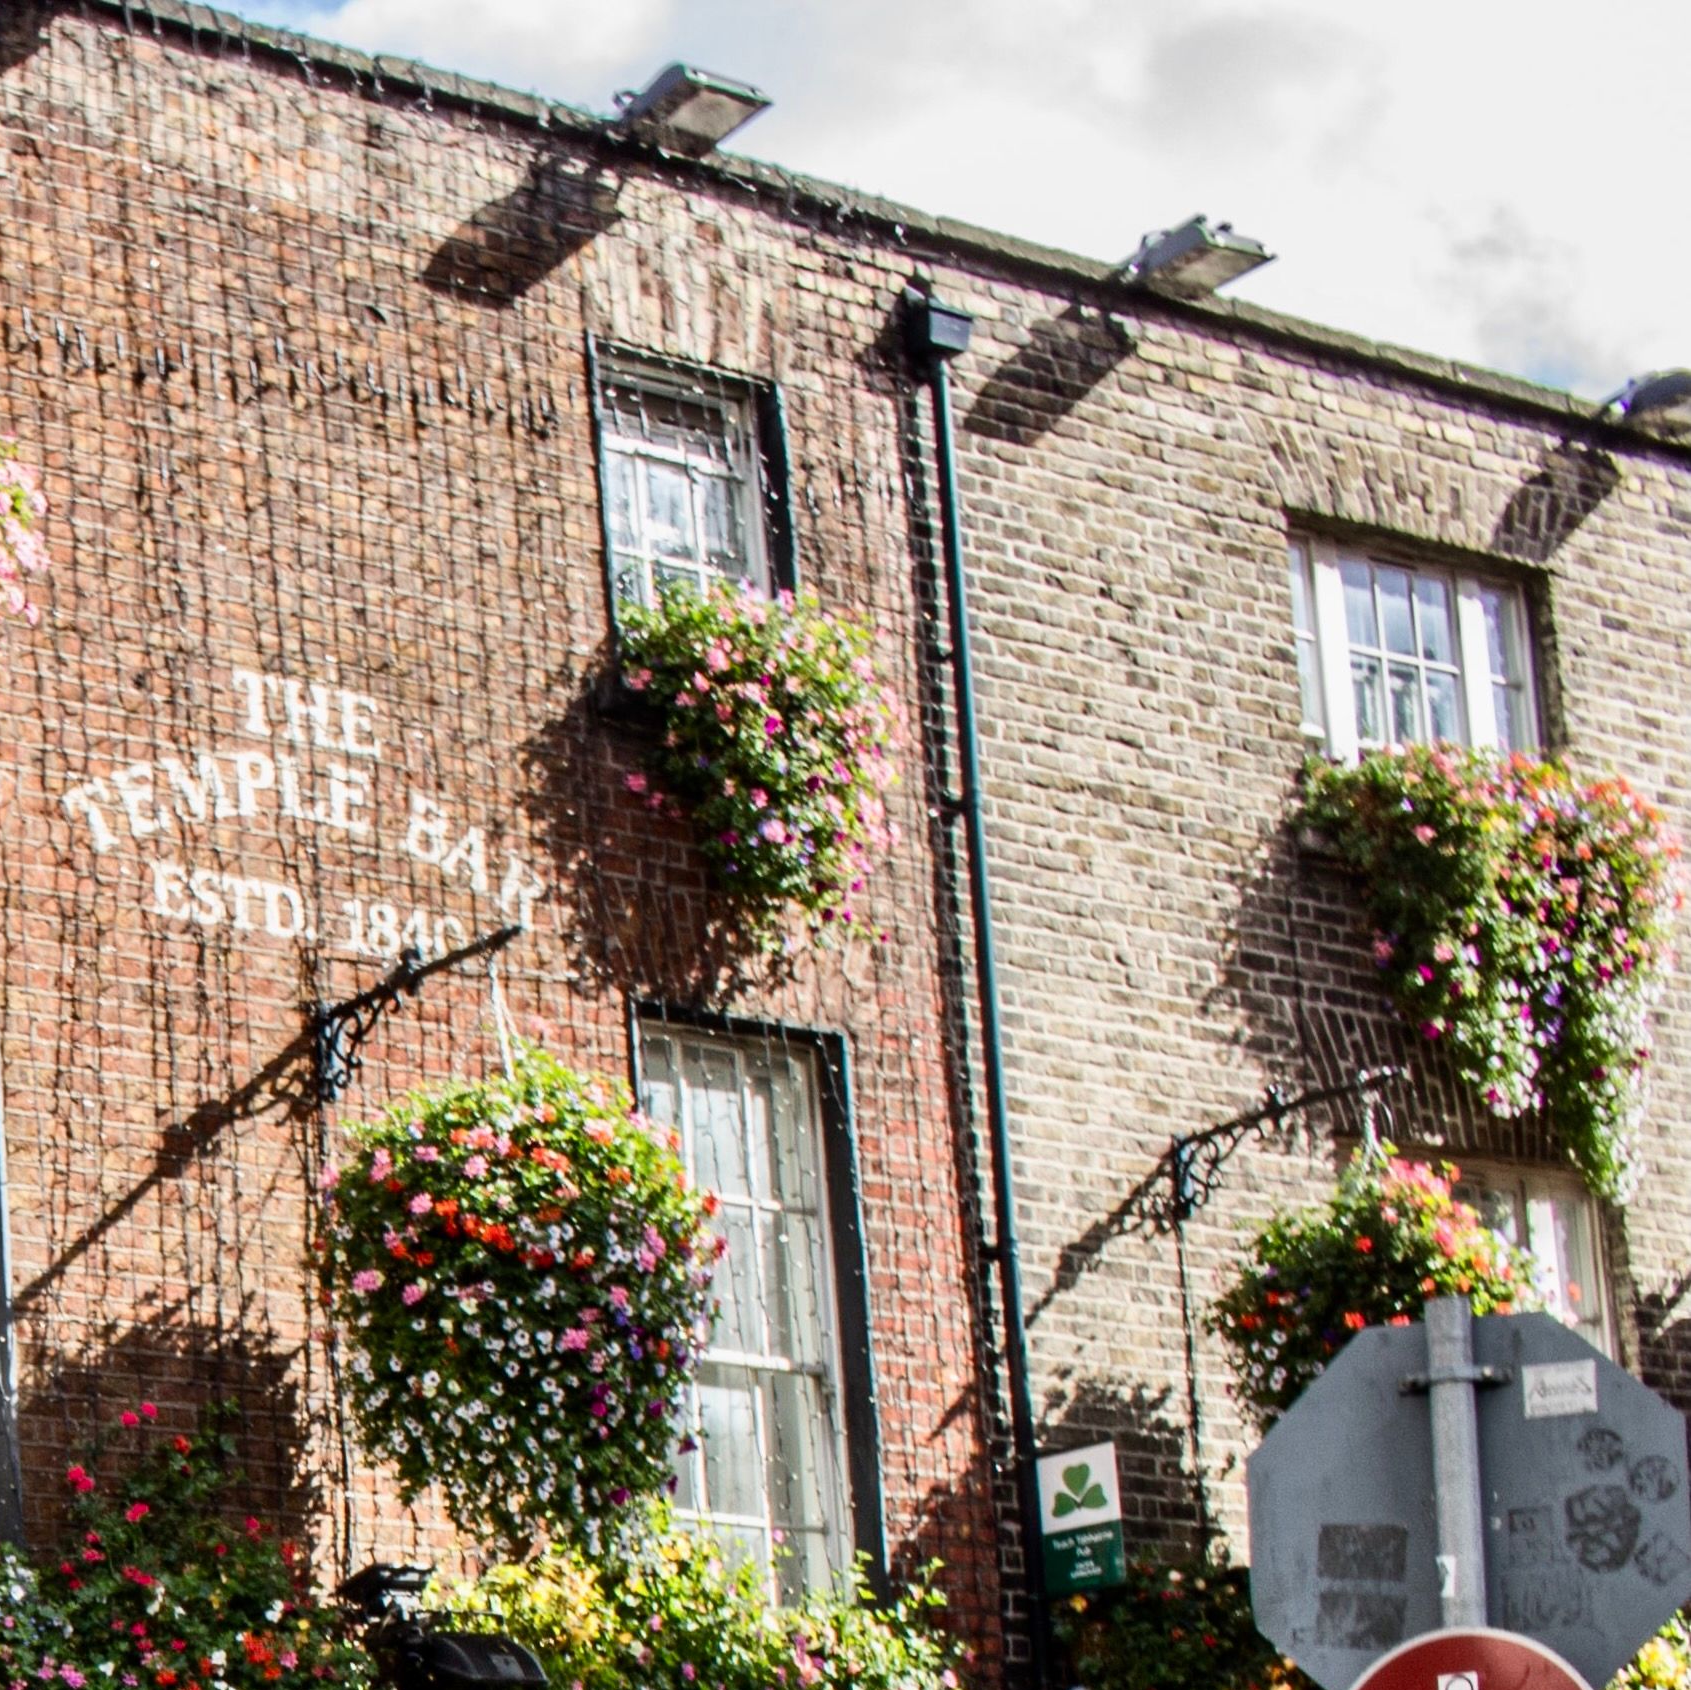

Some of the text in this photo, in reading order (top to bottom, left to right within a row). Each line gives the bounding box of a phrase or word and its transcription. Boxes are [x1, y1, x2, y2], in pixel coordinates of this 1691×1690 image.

[233, 668, 381, 758] THE
[61, 750, 545, 931] TEMPLE BAR
[151, 860, 467, 956] ESTD. 1840
